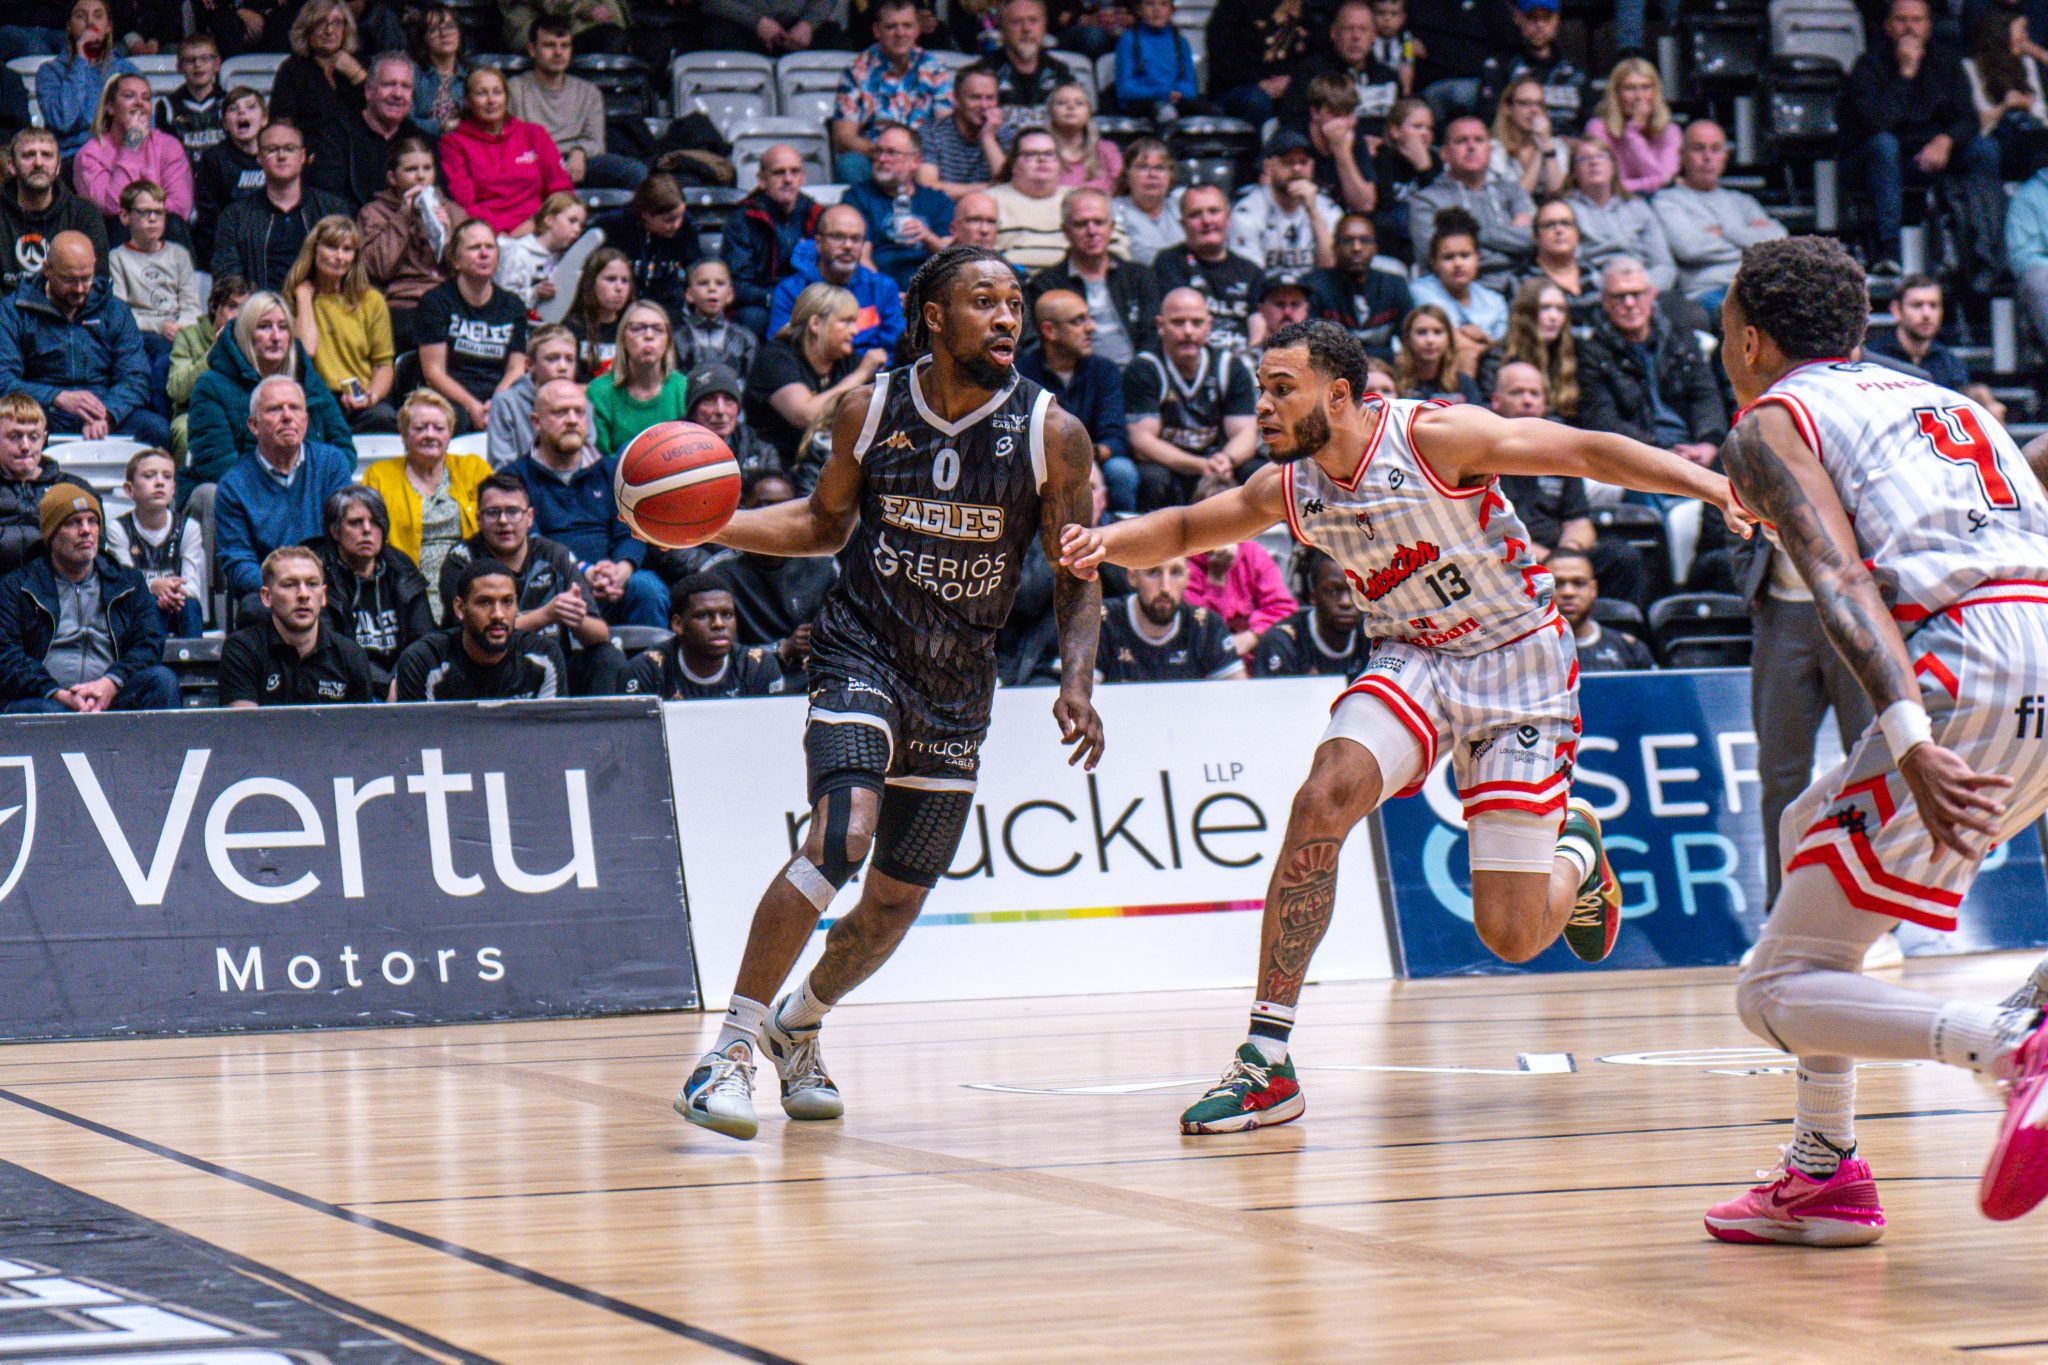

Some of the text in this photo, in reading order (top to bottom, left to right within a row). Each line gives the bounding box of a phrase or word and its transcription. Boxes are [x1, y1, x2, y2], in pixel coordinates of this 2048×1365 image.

[449, 313, 514, 344] EAGLES
[932, 448, 960, 491] 0
[1912, 404, 2021, 511] 4
[880, 495, 1004, 541] EAGLES
[1425, 562, 1472, 608] 13
[1204, 762, 1244, 783] LLP
[1500, 747, 1550, 762] LOUGHBOROUGH
[1513, 756, 1536, 765] SPORT
[61, 747, 599, 905] Vertu
[216, 945, 505, 992] Motors
